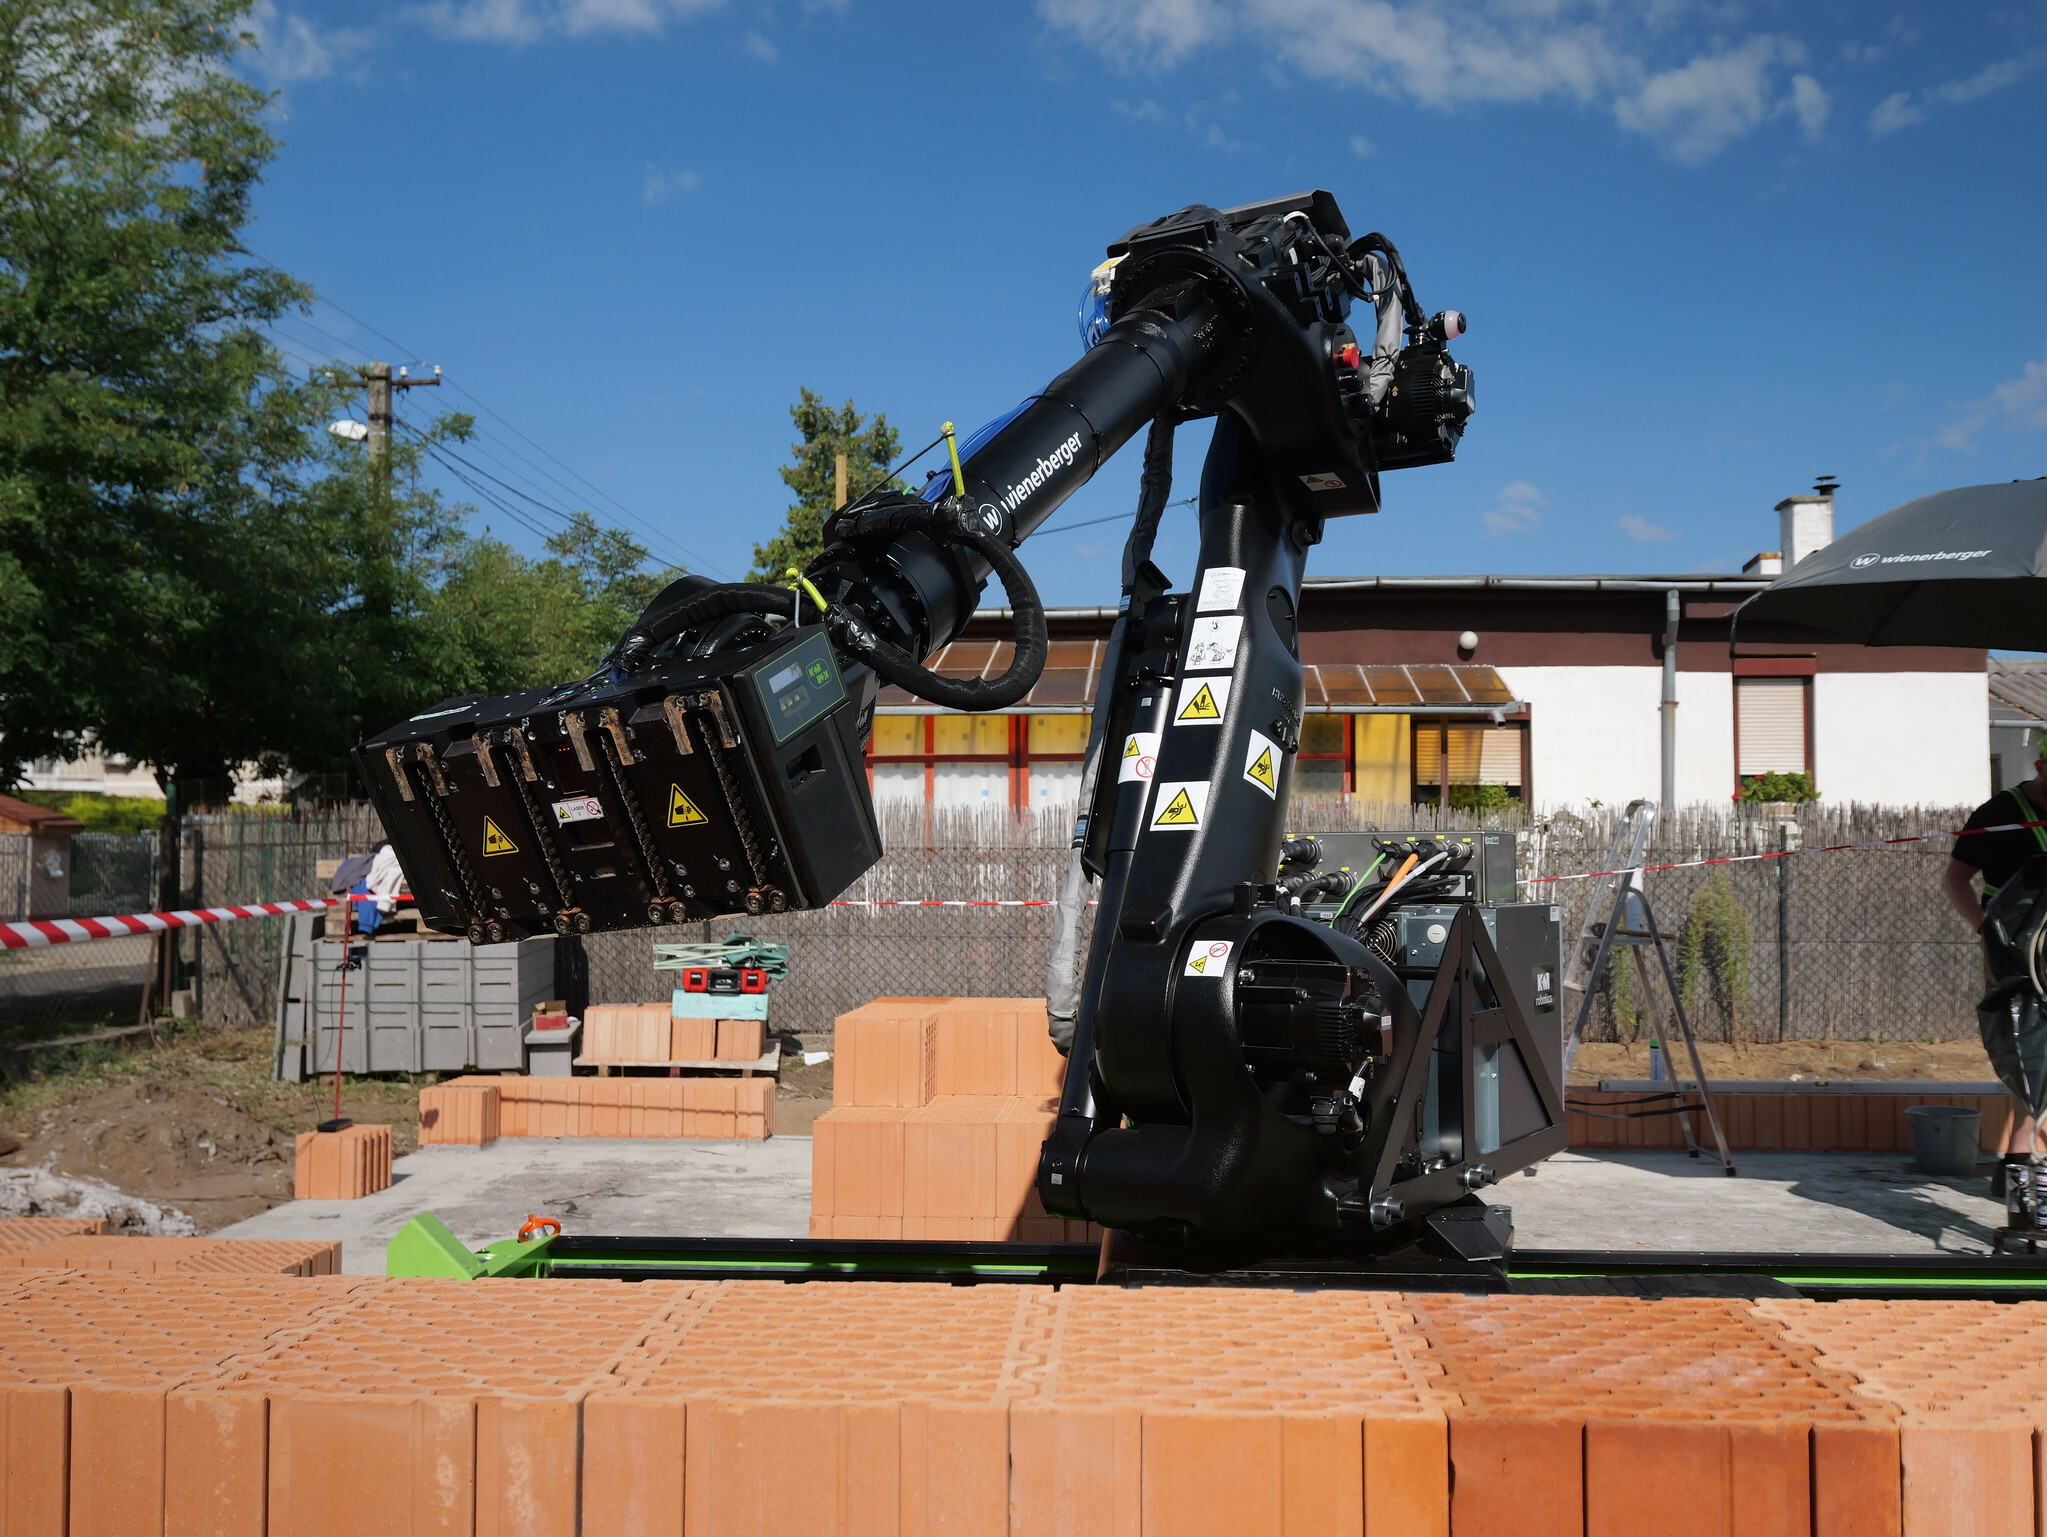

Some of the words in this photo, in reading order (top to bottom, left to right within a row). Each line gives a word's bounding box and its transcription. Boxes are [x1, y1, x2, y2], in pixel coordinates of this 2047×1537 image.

[1000, 431, 1083, 514] wienerberger
[1881, 550, 1992, 562] wienerberger
[1535, 993, 1553, 1006] robotics
